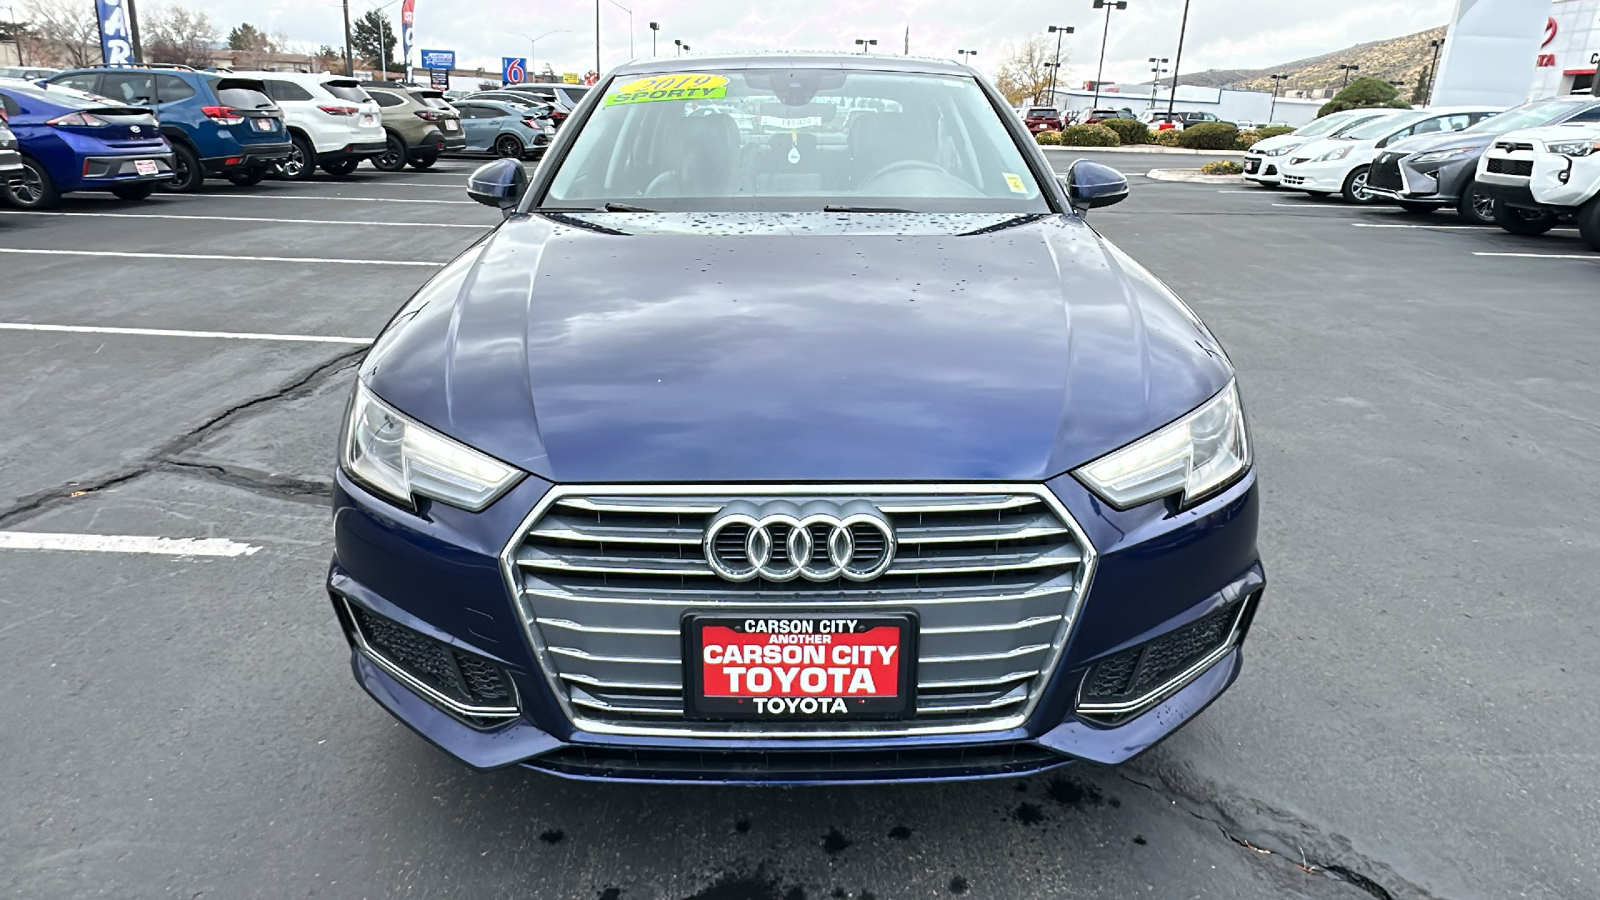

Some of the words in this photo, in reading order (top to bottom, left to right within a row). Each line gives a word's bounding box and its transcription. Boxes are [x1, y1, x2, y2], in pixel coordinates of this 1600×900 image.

[104, 0, 133, 69] AR
[1590, 53, 1600, 64] C
[507, 58, 525, 83] 6
[634, 76, 712, 92] 2019
[613, 87, 717, 103] SPORTY
[744, 619, 814, 634] CARSON
[819, 619, 858, 634] CITY
[768, 634, 832, 644] ANOTHER
[703, 645, 826, 664] CARSON
[832, 645, 897, 665] CITY
[723, 667, 876, 693] TOYOTA
[753, 697, 848, 714] TOYOTA
